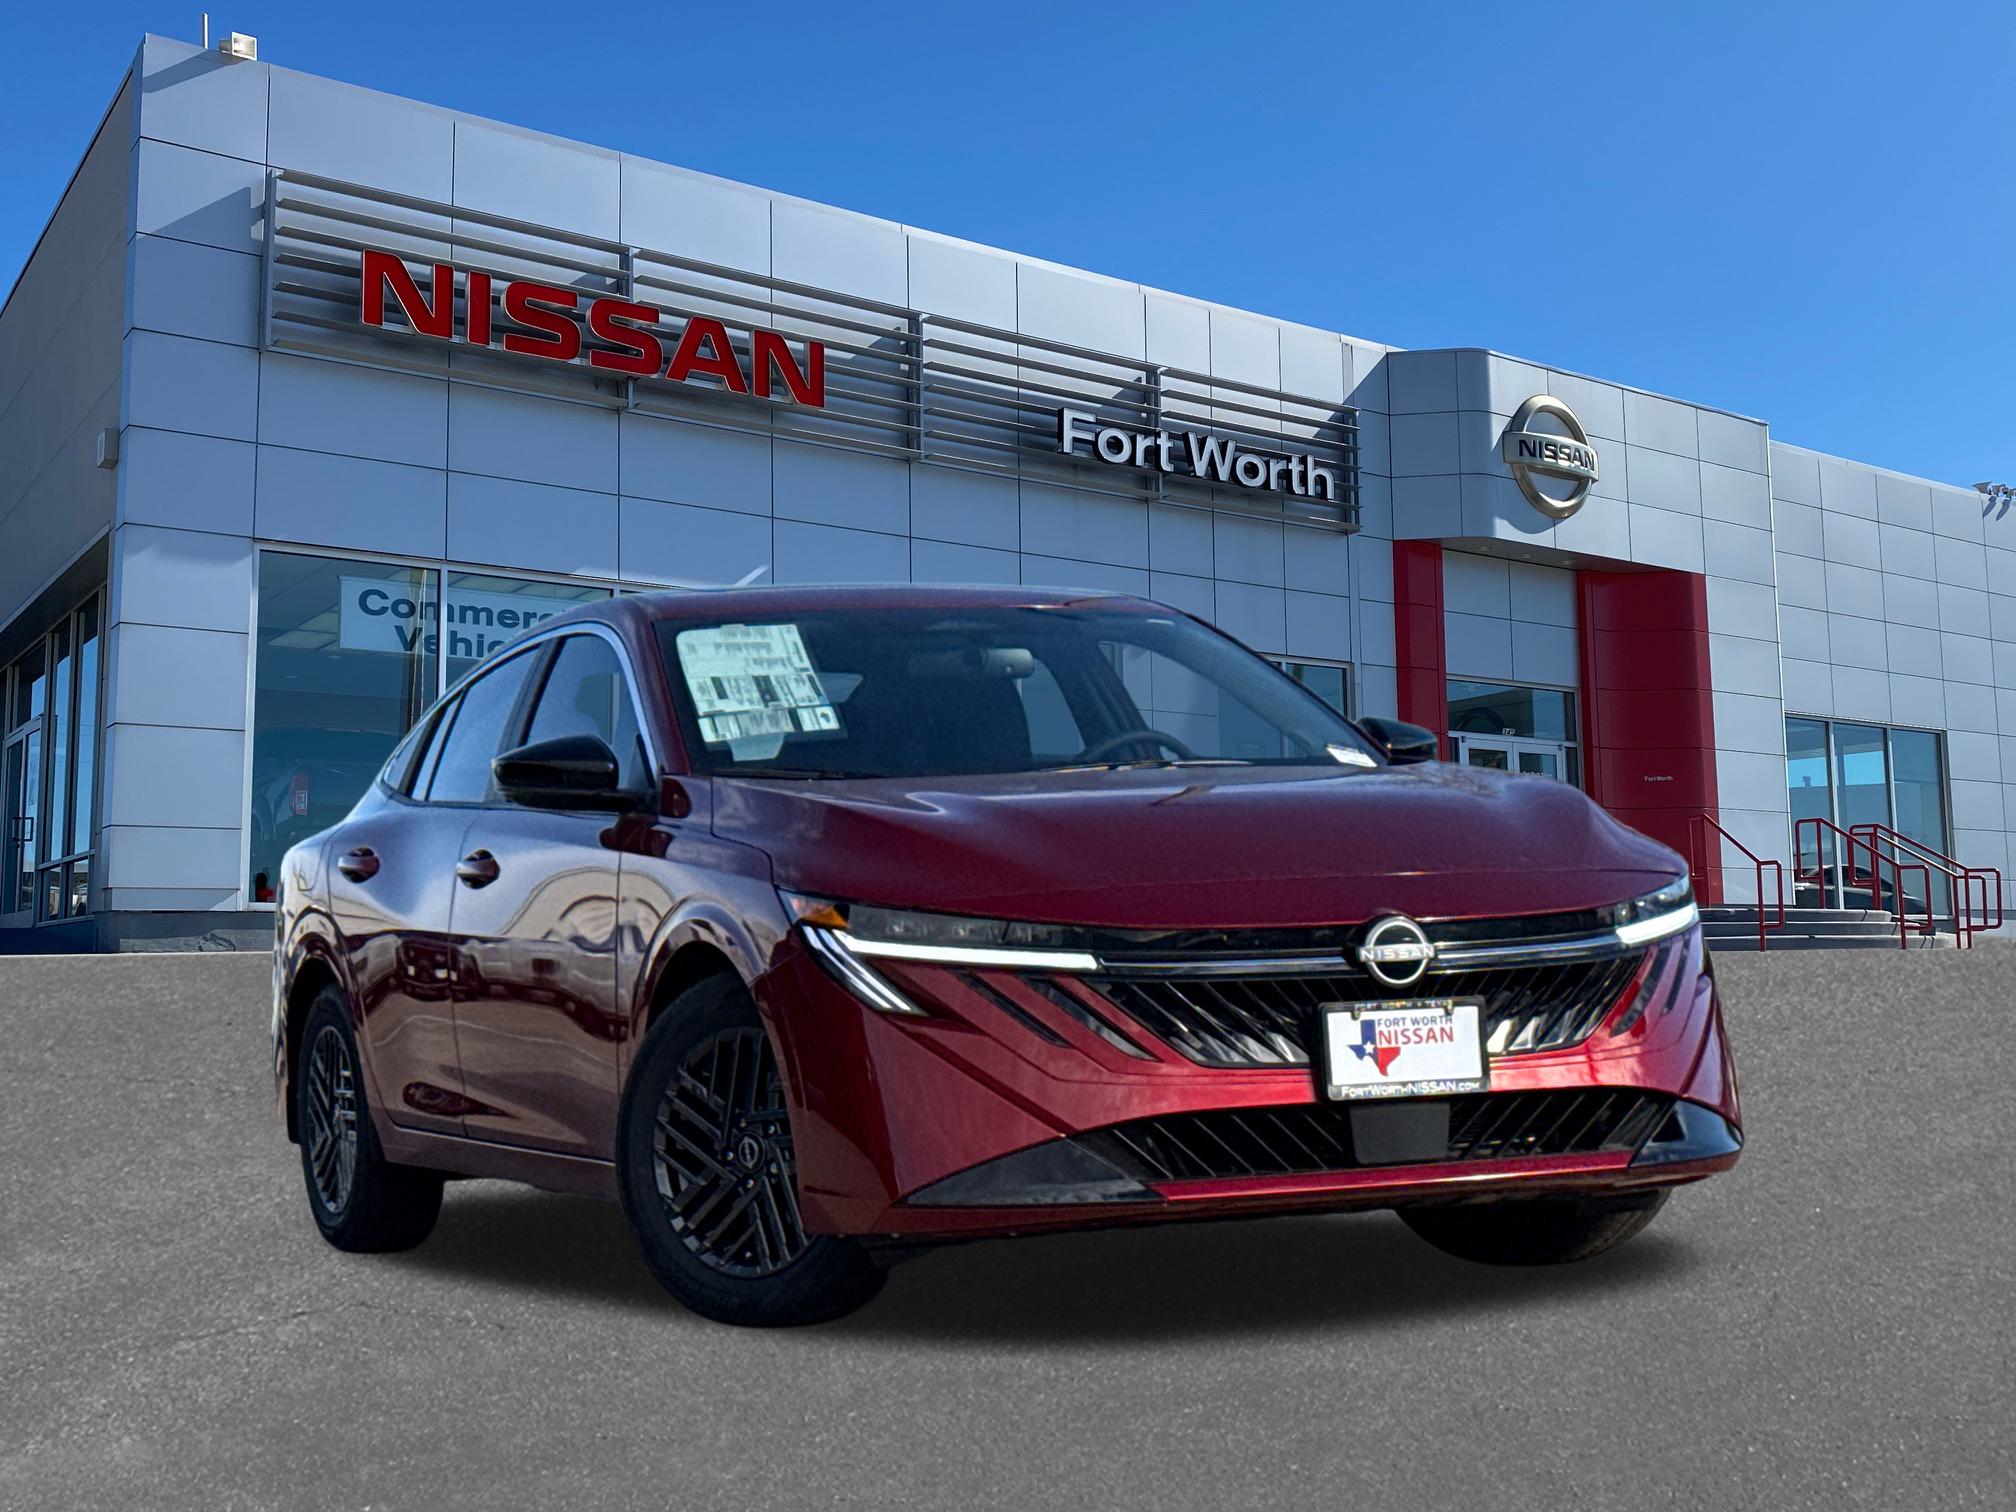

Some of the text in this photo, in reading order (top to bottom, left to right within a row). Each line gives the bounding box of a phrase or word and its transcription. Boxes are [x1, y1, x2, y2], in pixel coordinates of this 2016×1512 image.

[361, 249, 826, 409] NISSAN
[1059, 407, 1335, 500] Fort Worth
[1518, 439, 1595, 471] NISSAN
[358, 588, 555, 629] Commer
[1360, 945, 1434, 961] NISSAN
[1377, 1014, 1453, 1028] FORT WORTH
[1378, 1026, 1454, 1045] NISSAN
